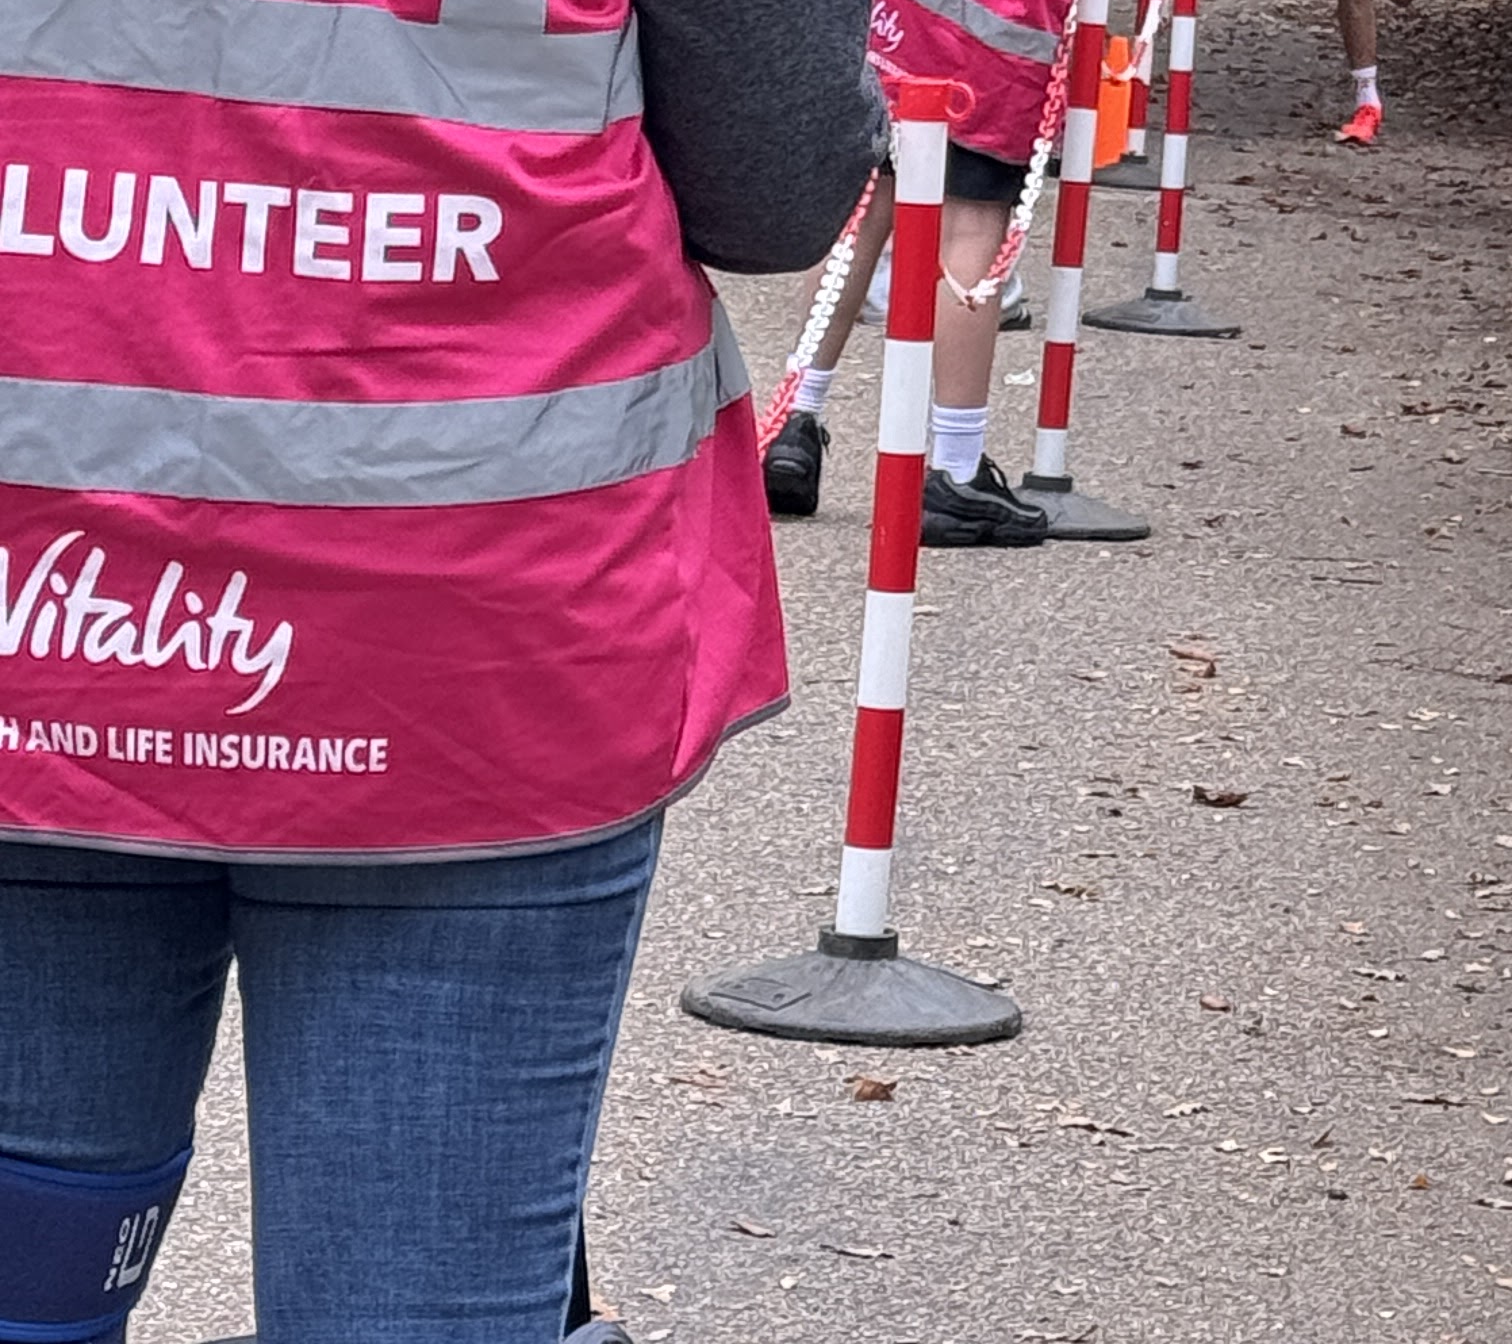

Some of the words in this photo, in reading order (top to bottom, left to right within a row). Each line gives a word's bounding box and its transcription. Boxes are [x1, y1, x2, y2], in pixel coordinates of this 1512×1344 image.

[0, 529, 294, 716] Vitality
[25, 720, 99, 758] AND
[106, 726, 174, 765] LIFE
[183, 731, 390, 773] INSURANCE
